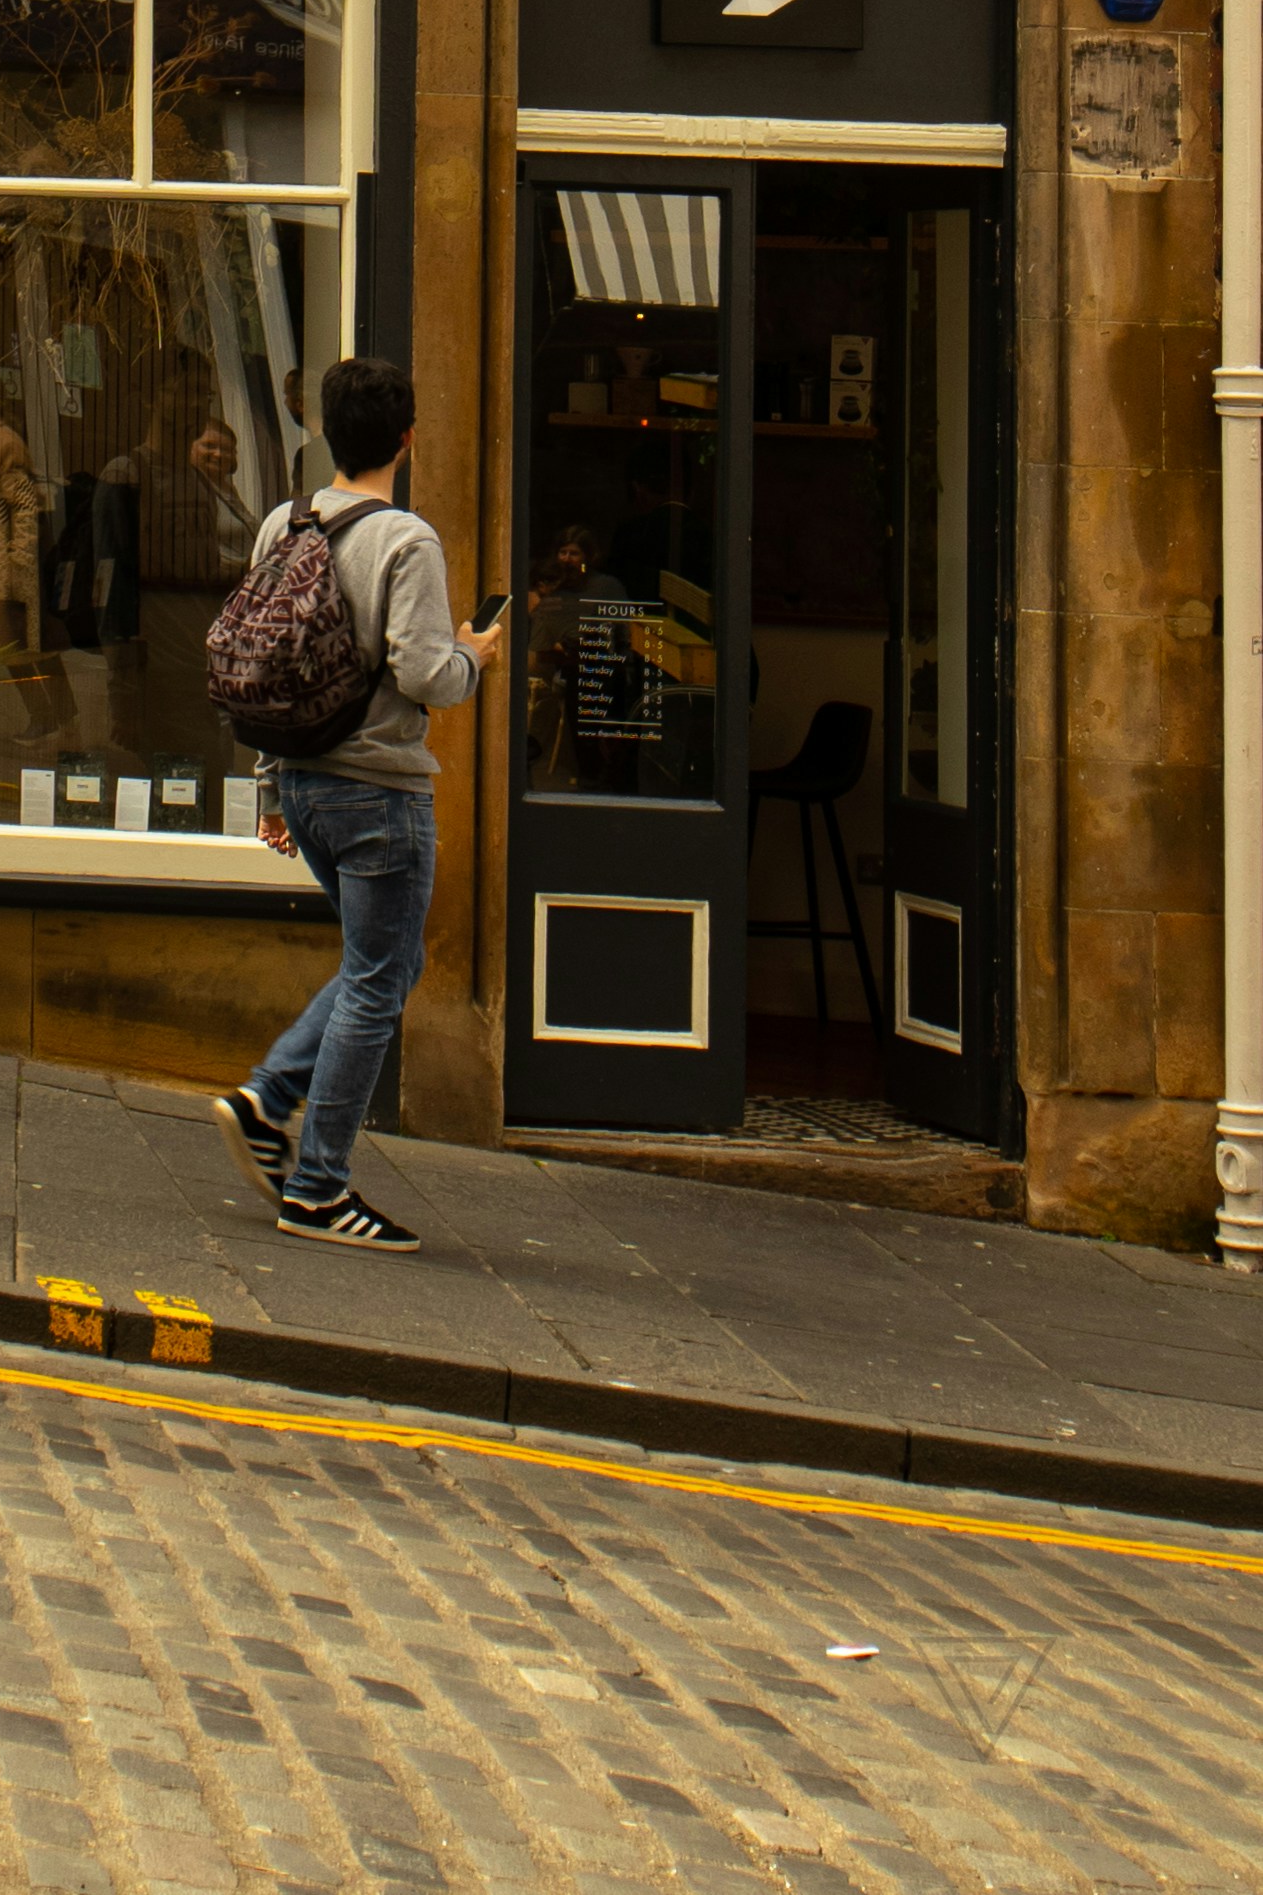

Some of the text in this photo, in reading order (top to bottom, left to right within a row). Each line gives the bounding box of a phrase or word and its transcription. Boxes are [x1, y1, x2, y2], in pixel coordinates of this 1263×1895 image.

[597, 604, 645, 617] HOURS
[578, 623, 613, 636] Monday
[578, 637, 612, 649] Tuesday
[578, 651, 627, 664] Wednesday
[577, 677, 604, 690] Friday
